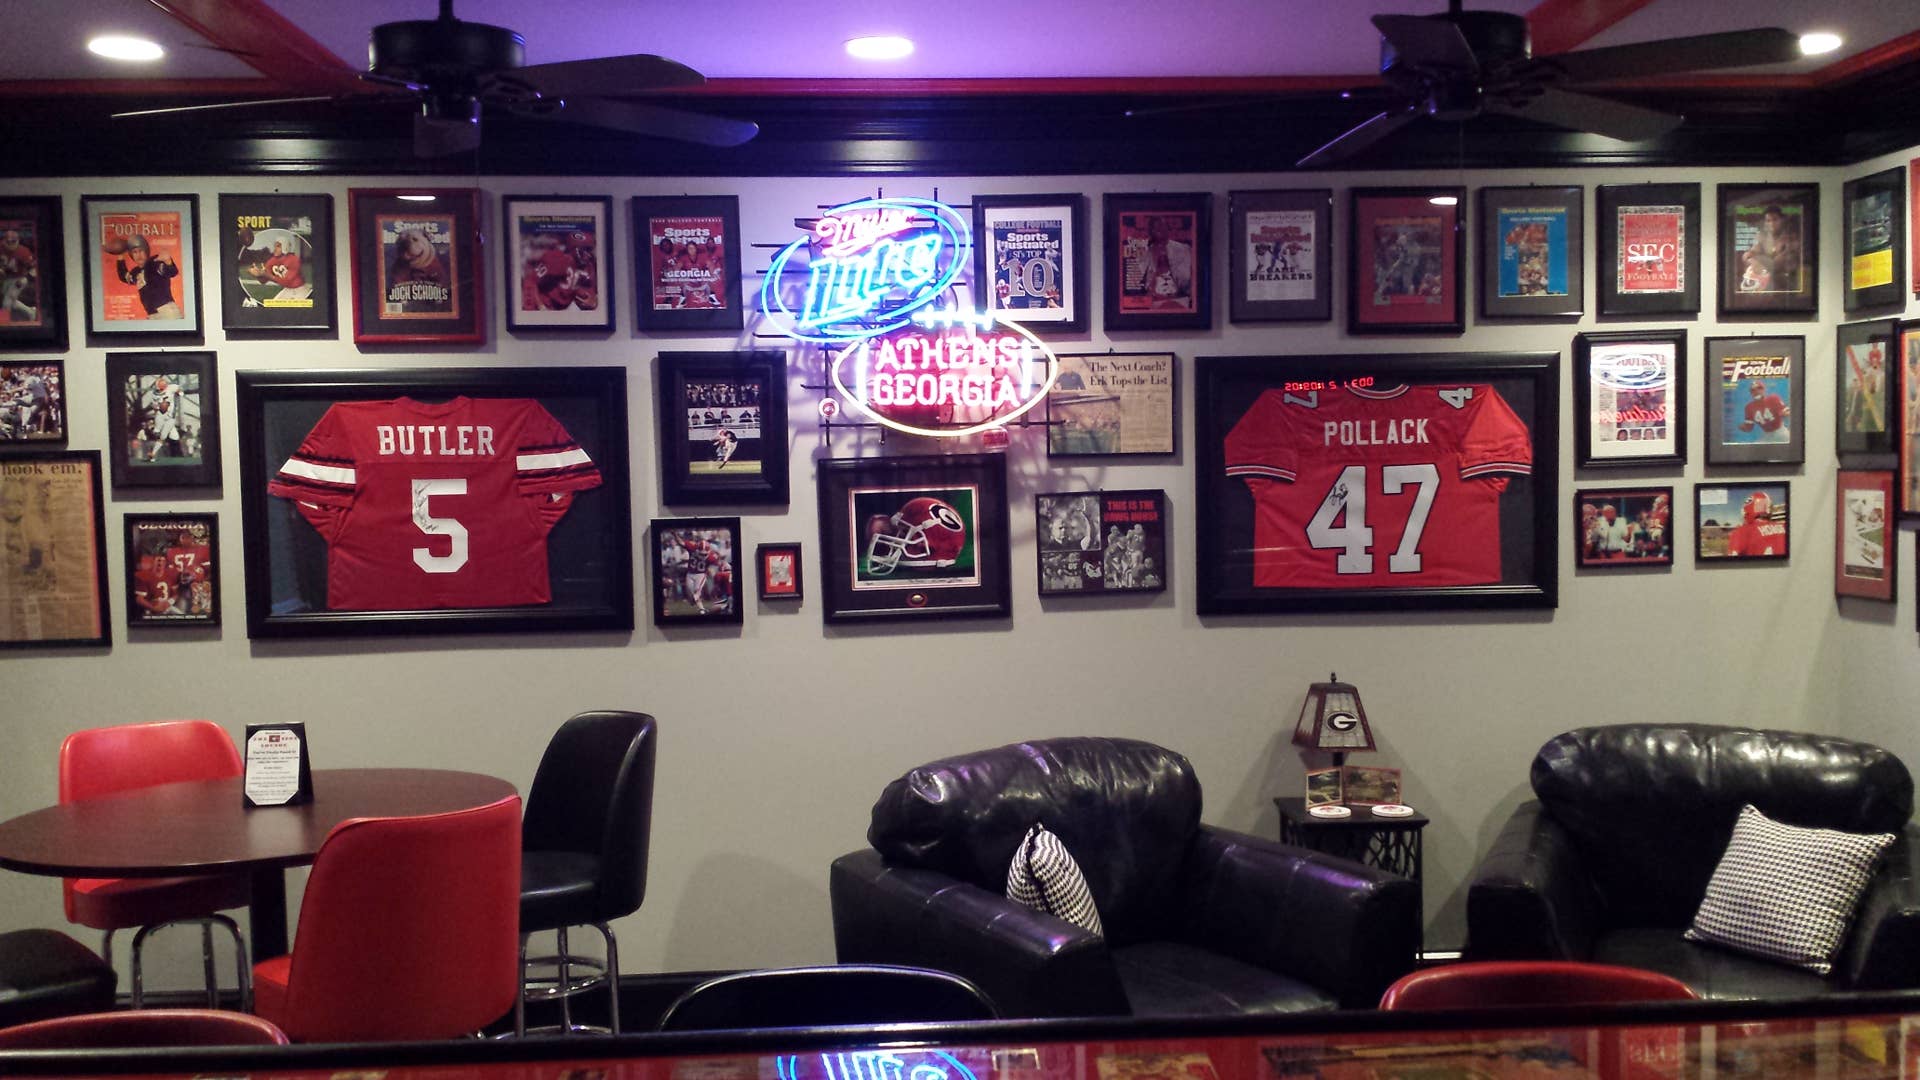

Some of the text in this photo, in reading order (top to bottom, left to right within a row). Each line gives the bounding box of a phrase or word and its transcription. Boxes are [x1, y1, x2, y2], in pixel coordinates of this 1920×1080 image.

[100, 214, 175, 246] FOOTBALL
[237, 215, 272, 228] SPORT
[664, 227, 710, 239] Sports
[996, 238, 1059, 250] Illustrated
[1007, 232, 1049, 243] Sports
[666, 269, 712, 278] GEORGIA
[1003, 257, 1055, 297] 10
[875, 337, 1019, 371] ATHENS
[1091, 361, 1167, 372] The Next Coach?
[1731, 356, 1791, 382] Football
[873, 373, 1021, 407] GEORGIA
[1111, 376, 1131, 388] Tops
[1132, 375, 1147, 385] the
[1151, 374, 1168, 385] List
[377, 425, 495, 456] BUTLER
[1324, 419, 1430, 446] POLLACK
[411, 478, 469, 573] 5
[1305, 464, 1441, 575] 47
[174, 553, 196, 573] 57
[156, 581, 169, 601] 3
